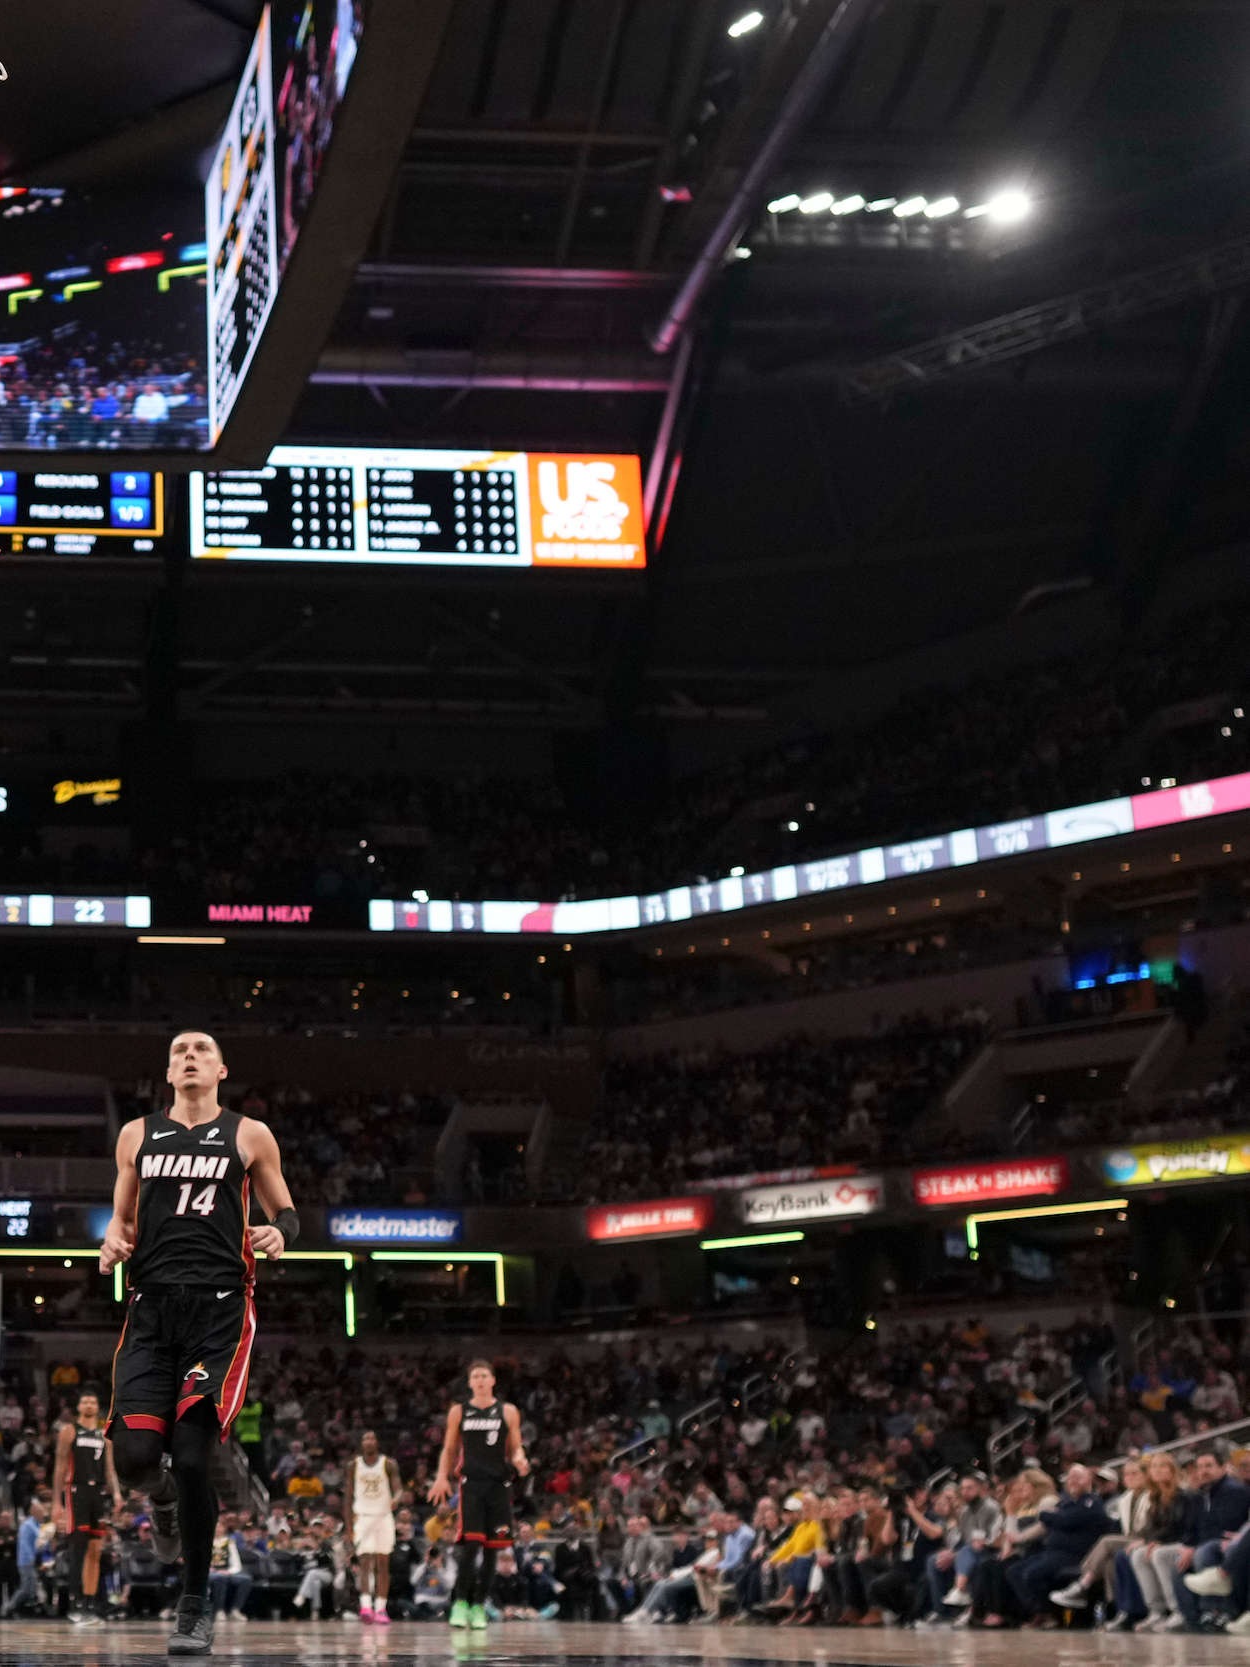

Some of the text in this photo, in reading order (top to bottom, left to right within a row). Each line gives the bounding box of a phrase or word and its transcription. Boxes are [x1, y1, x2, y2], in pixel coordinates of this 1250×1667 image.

[7, 906, 19, 922] 2
[74, 900, 105, 922] 22
[208, 905, 313, 922] MIAMI HEAT
[141, 1153, 230, 1180] MIAMI
[919, 1175, 979, 1198] STEAK
[995, 1164, 1061, 1190] SHAKE
[0, 1201, 31, 1216] HEAT
[175, 1182, 218, 1216] 14
[746, 1190, 831, 1219] KeyBank
[7, 1218, 29, 1236] 22
[330, 1213, 459, 1240] ticketmaster
[463, 1418, 501, 1431] MIAMI
